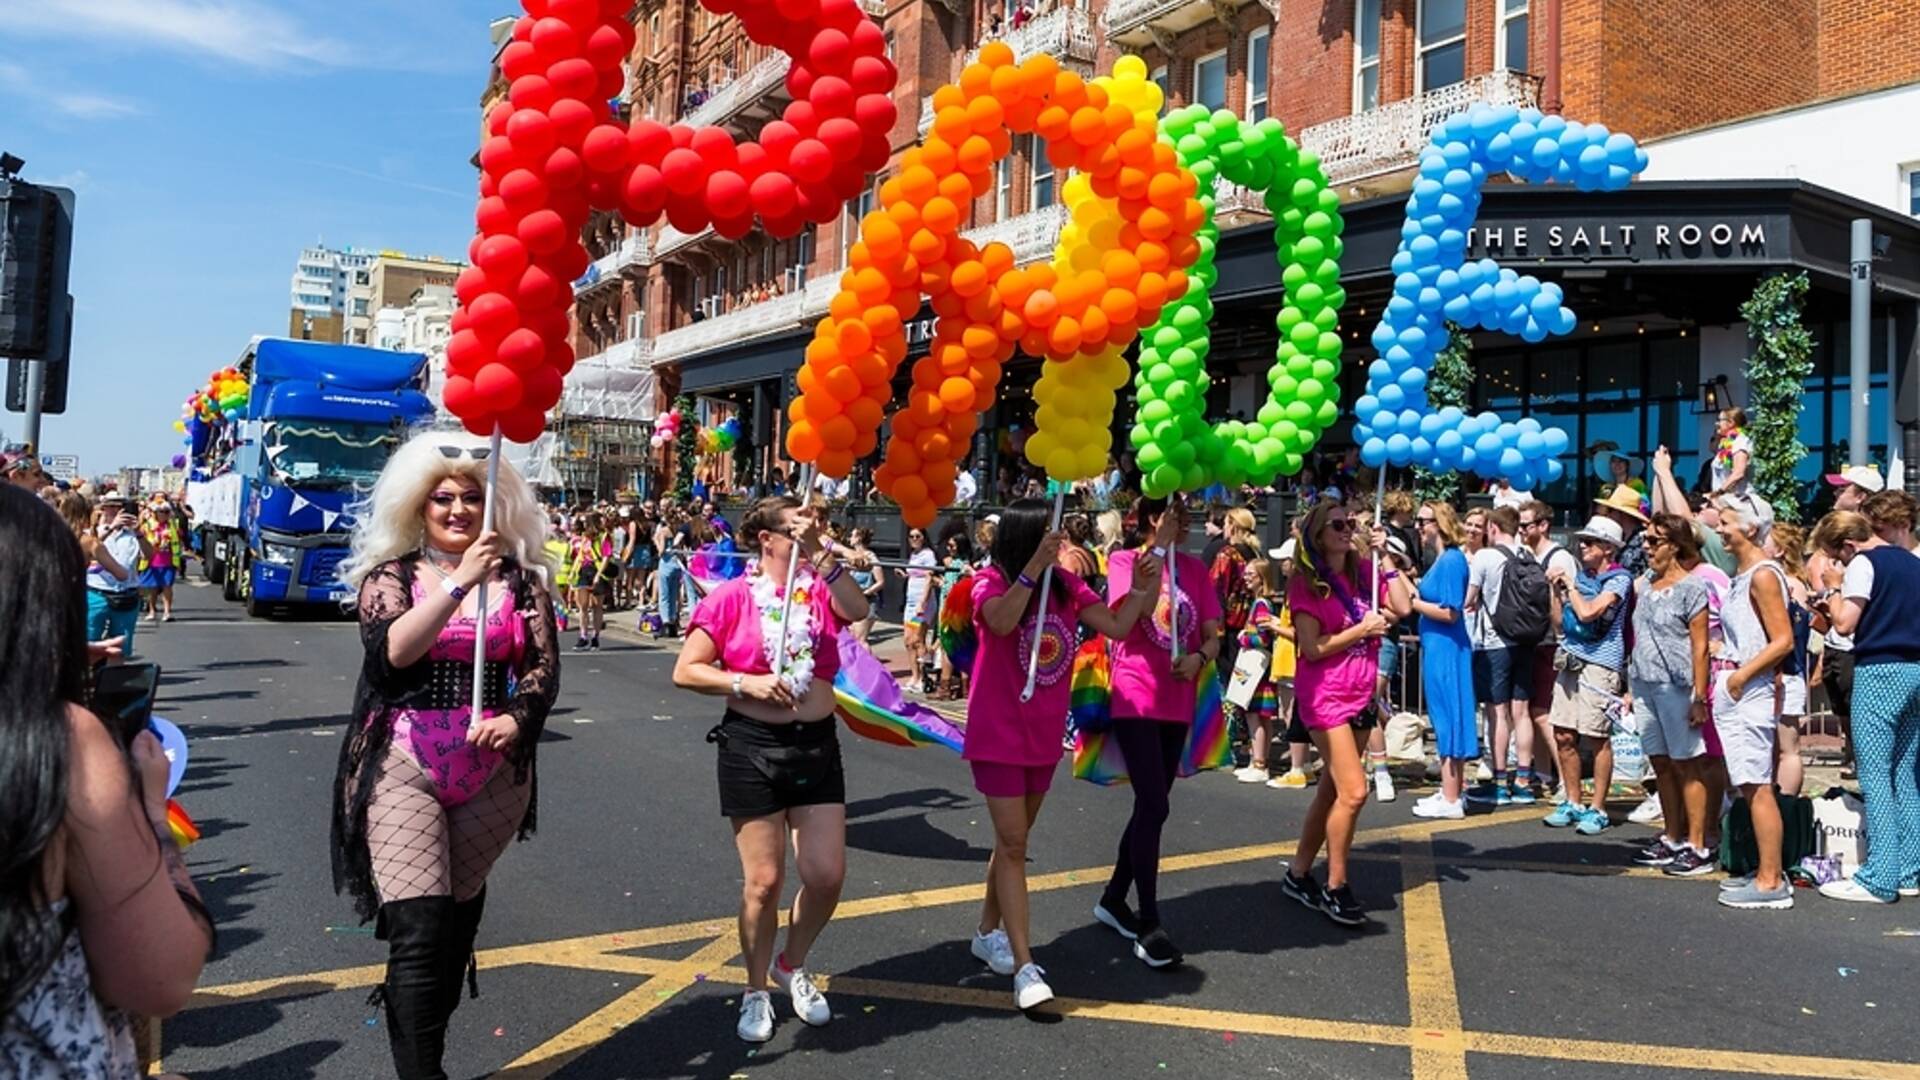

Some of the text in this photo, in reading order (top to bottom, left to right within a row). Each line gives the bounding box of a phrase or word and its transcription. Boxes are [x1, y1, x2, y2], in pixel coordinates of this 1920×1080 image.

[1466, 223, 1766, 247] THE SALT ROOM
